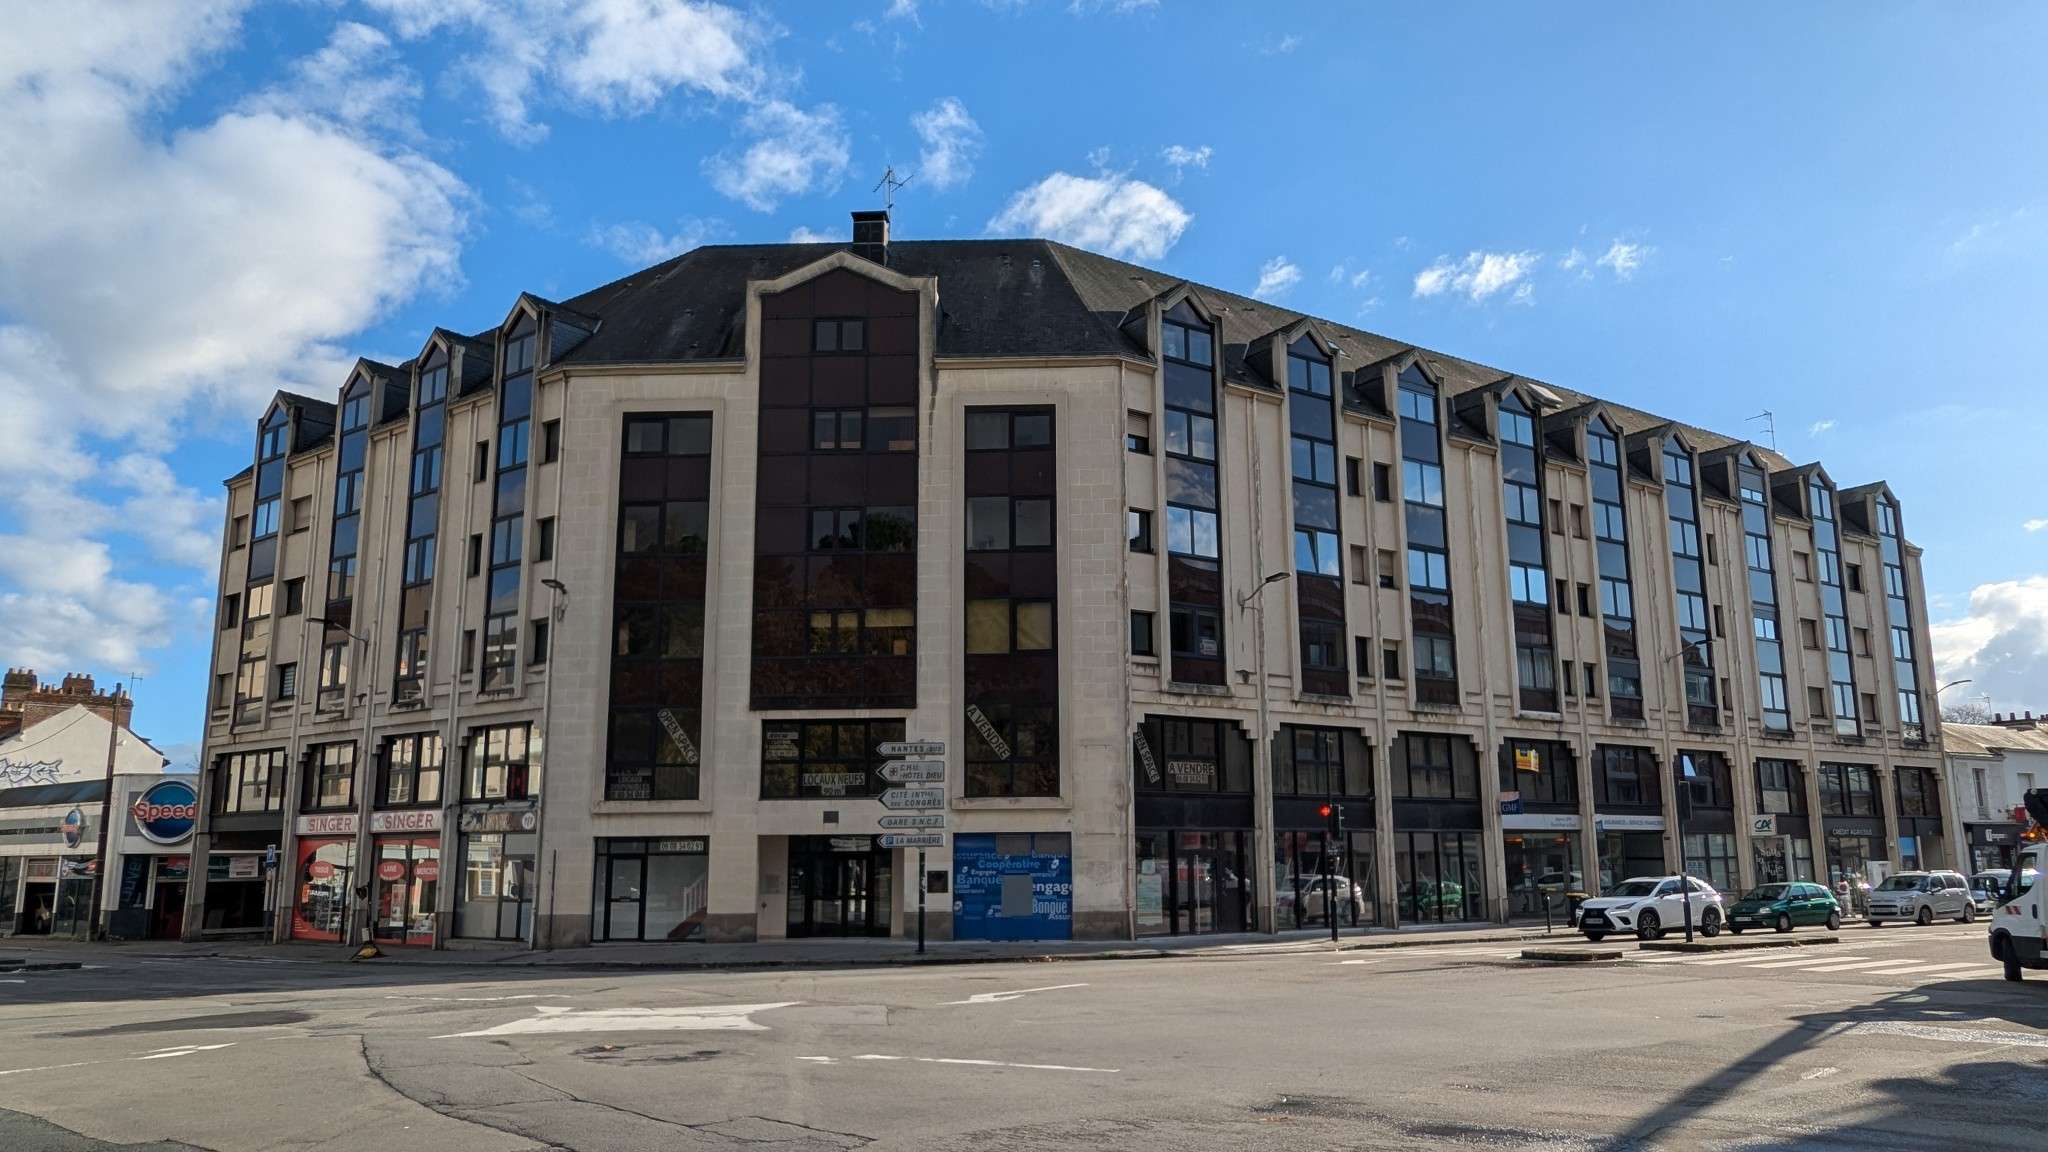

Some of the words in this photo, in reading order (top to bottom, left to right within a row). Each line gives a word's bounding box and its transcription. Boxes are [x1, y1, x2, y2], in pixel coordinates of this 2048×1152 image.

[975, 714, 1010, 758] VENDRE
[891, 745, 924, 753] NANTES
[1177, 763, 1215, 775] VENDRE
[803, 774, 836, 785] LOCAUX
[838, 773, 865, 785] NEUFS
[134, 801, 198, 822] Speed
[308, 817, 352, 832] SINGER
[384, 813, 434, 829] SINGER
[956, 874, 1002, 888] Banque
[1032, 898, 1067, 916] Banque
